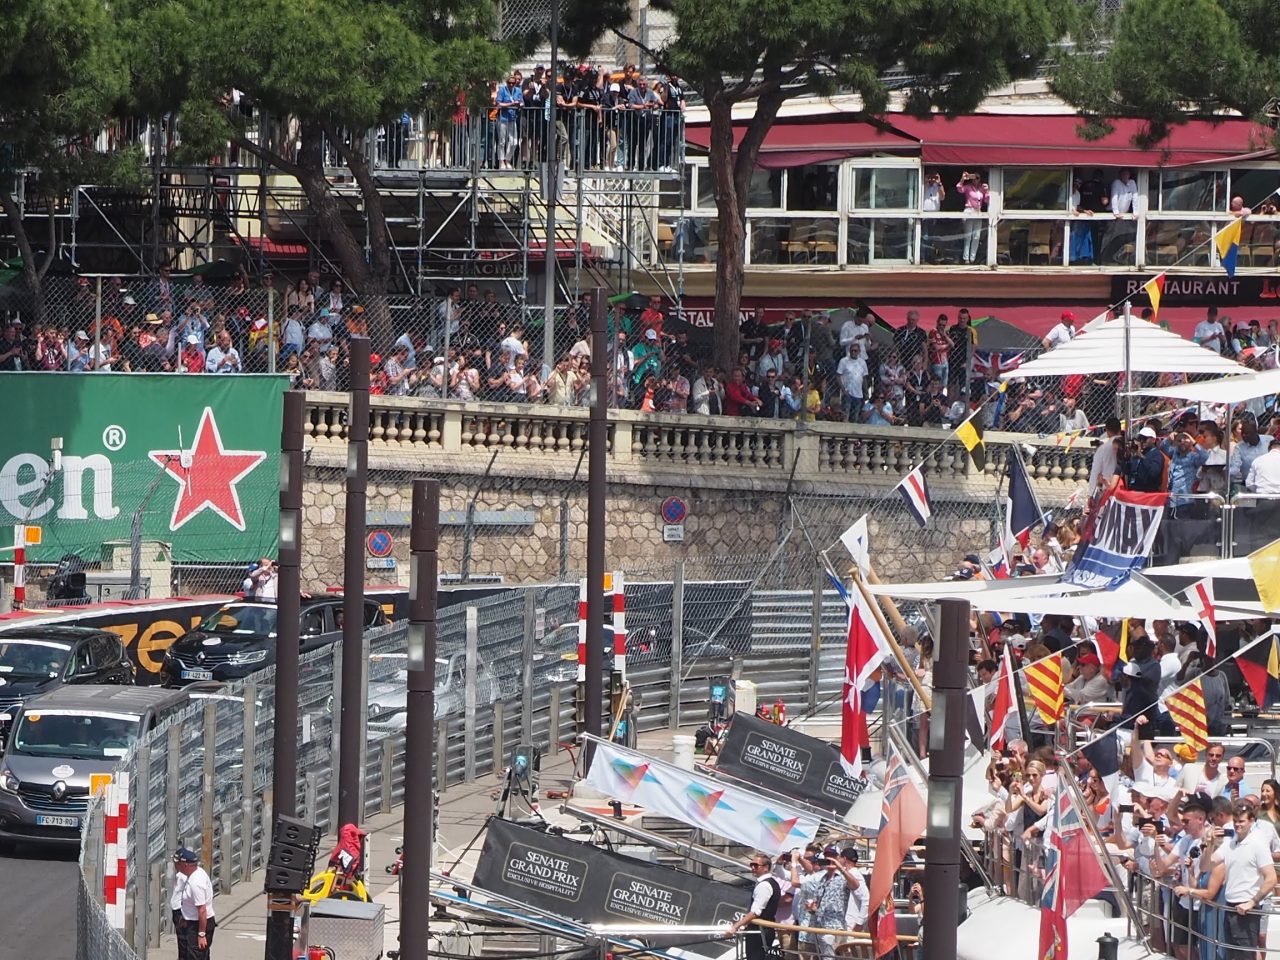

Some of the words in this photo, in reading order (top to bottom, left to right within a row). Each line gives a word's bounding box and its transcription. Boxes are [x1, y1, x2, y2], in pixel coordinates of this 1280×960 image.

[1126, 280, 1240, 296] RETAURANT
[747, 744, 782, 767] GRAND
[782, 756, 805, 772] PRIX
[760, 739, 796, 759] SENATE
[525, 851, 569, 871] SENATE
[509, 858, 551, 879] GRAND
[551, 870, 580, 887] PRIX
[507, 871, 538, 886] EXCLUSIVE
[538, 881, 576, 896] HOSPITALITY
[629, 881, 673, 901] SENATE
[610, 902, 641, 917] EXCLUSIVE
[613, 888, 655, 909] GRAND
[655, 900, 684, 917] PRIX
